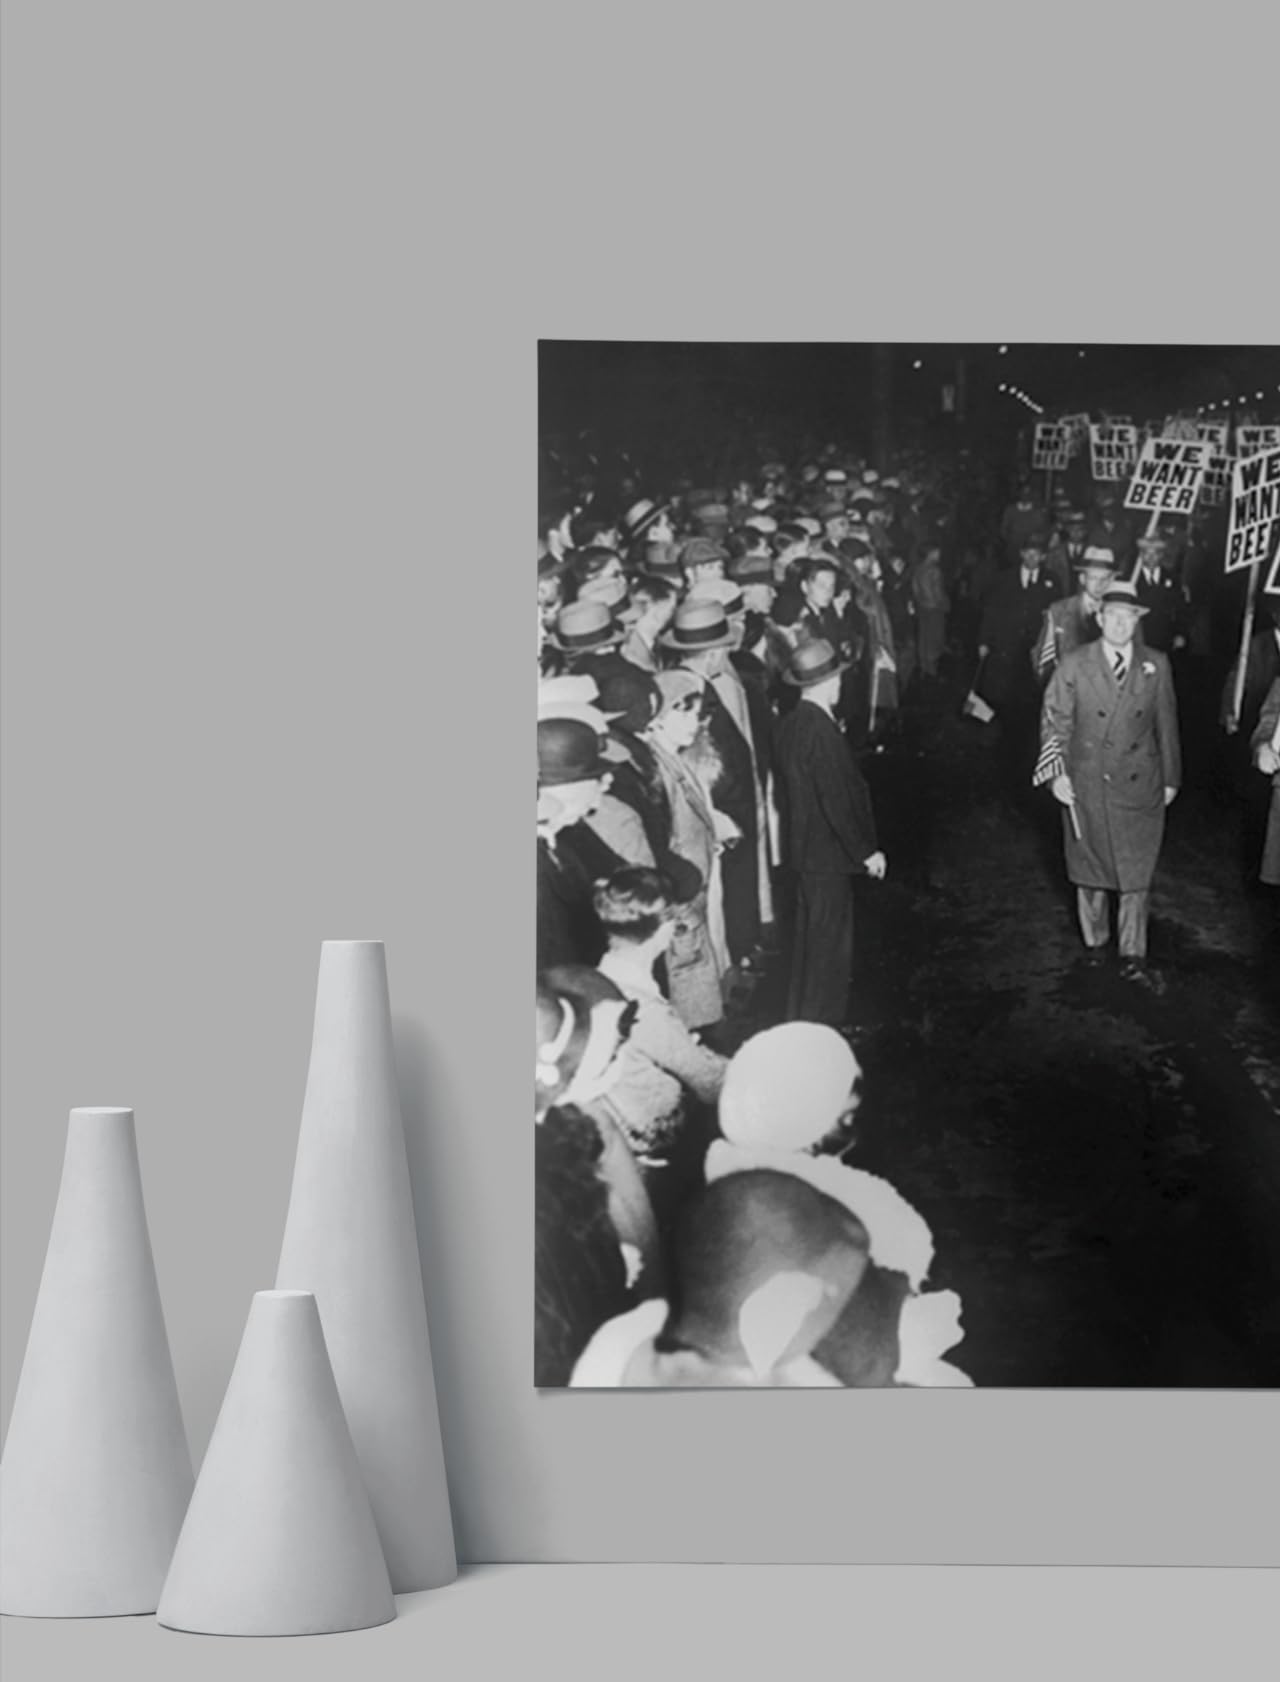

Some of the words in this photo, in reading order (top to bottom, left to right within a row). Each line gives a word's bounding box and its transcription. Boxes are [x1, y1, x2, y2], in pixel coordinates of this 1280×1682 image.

[1242, 429, 1276, 443] WE
[1154, 442, 1203, 463] WE
[1140, 460, 1202, 486] WANT
[1129, 483, 1194, 509] BEER
